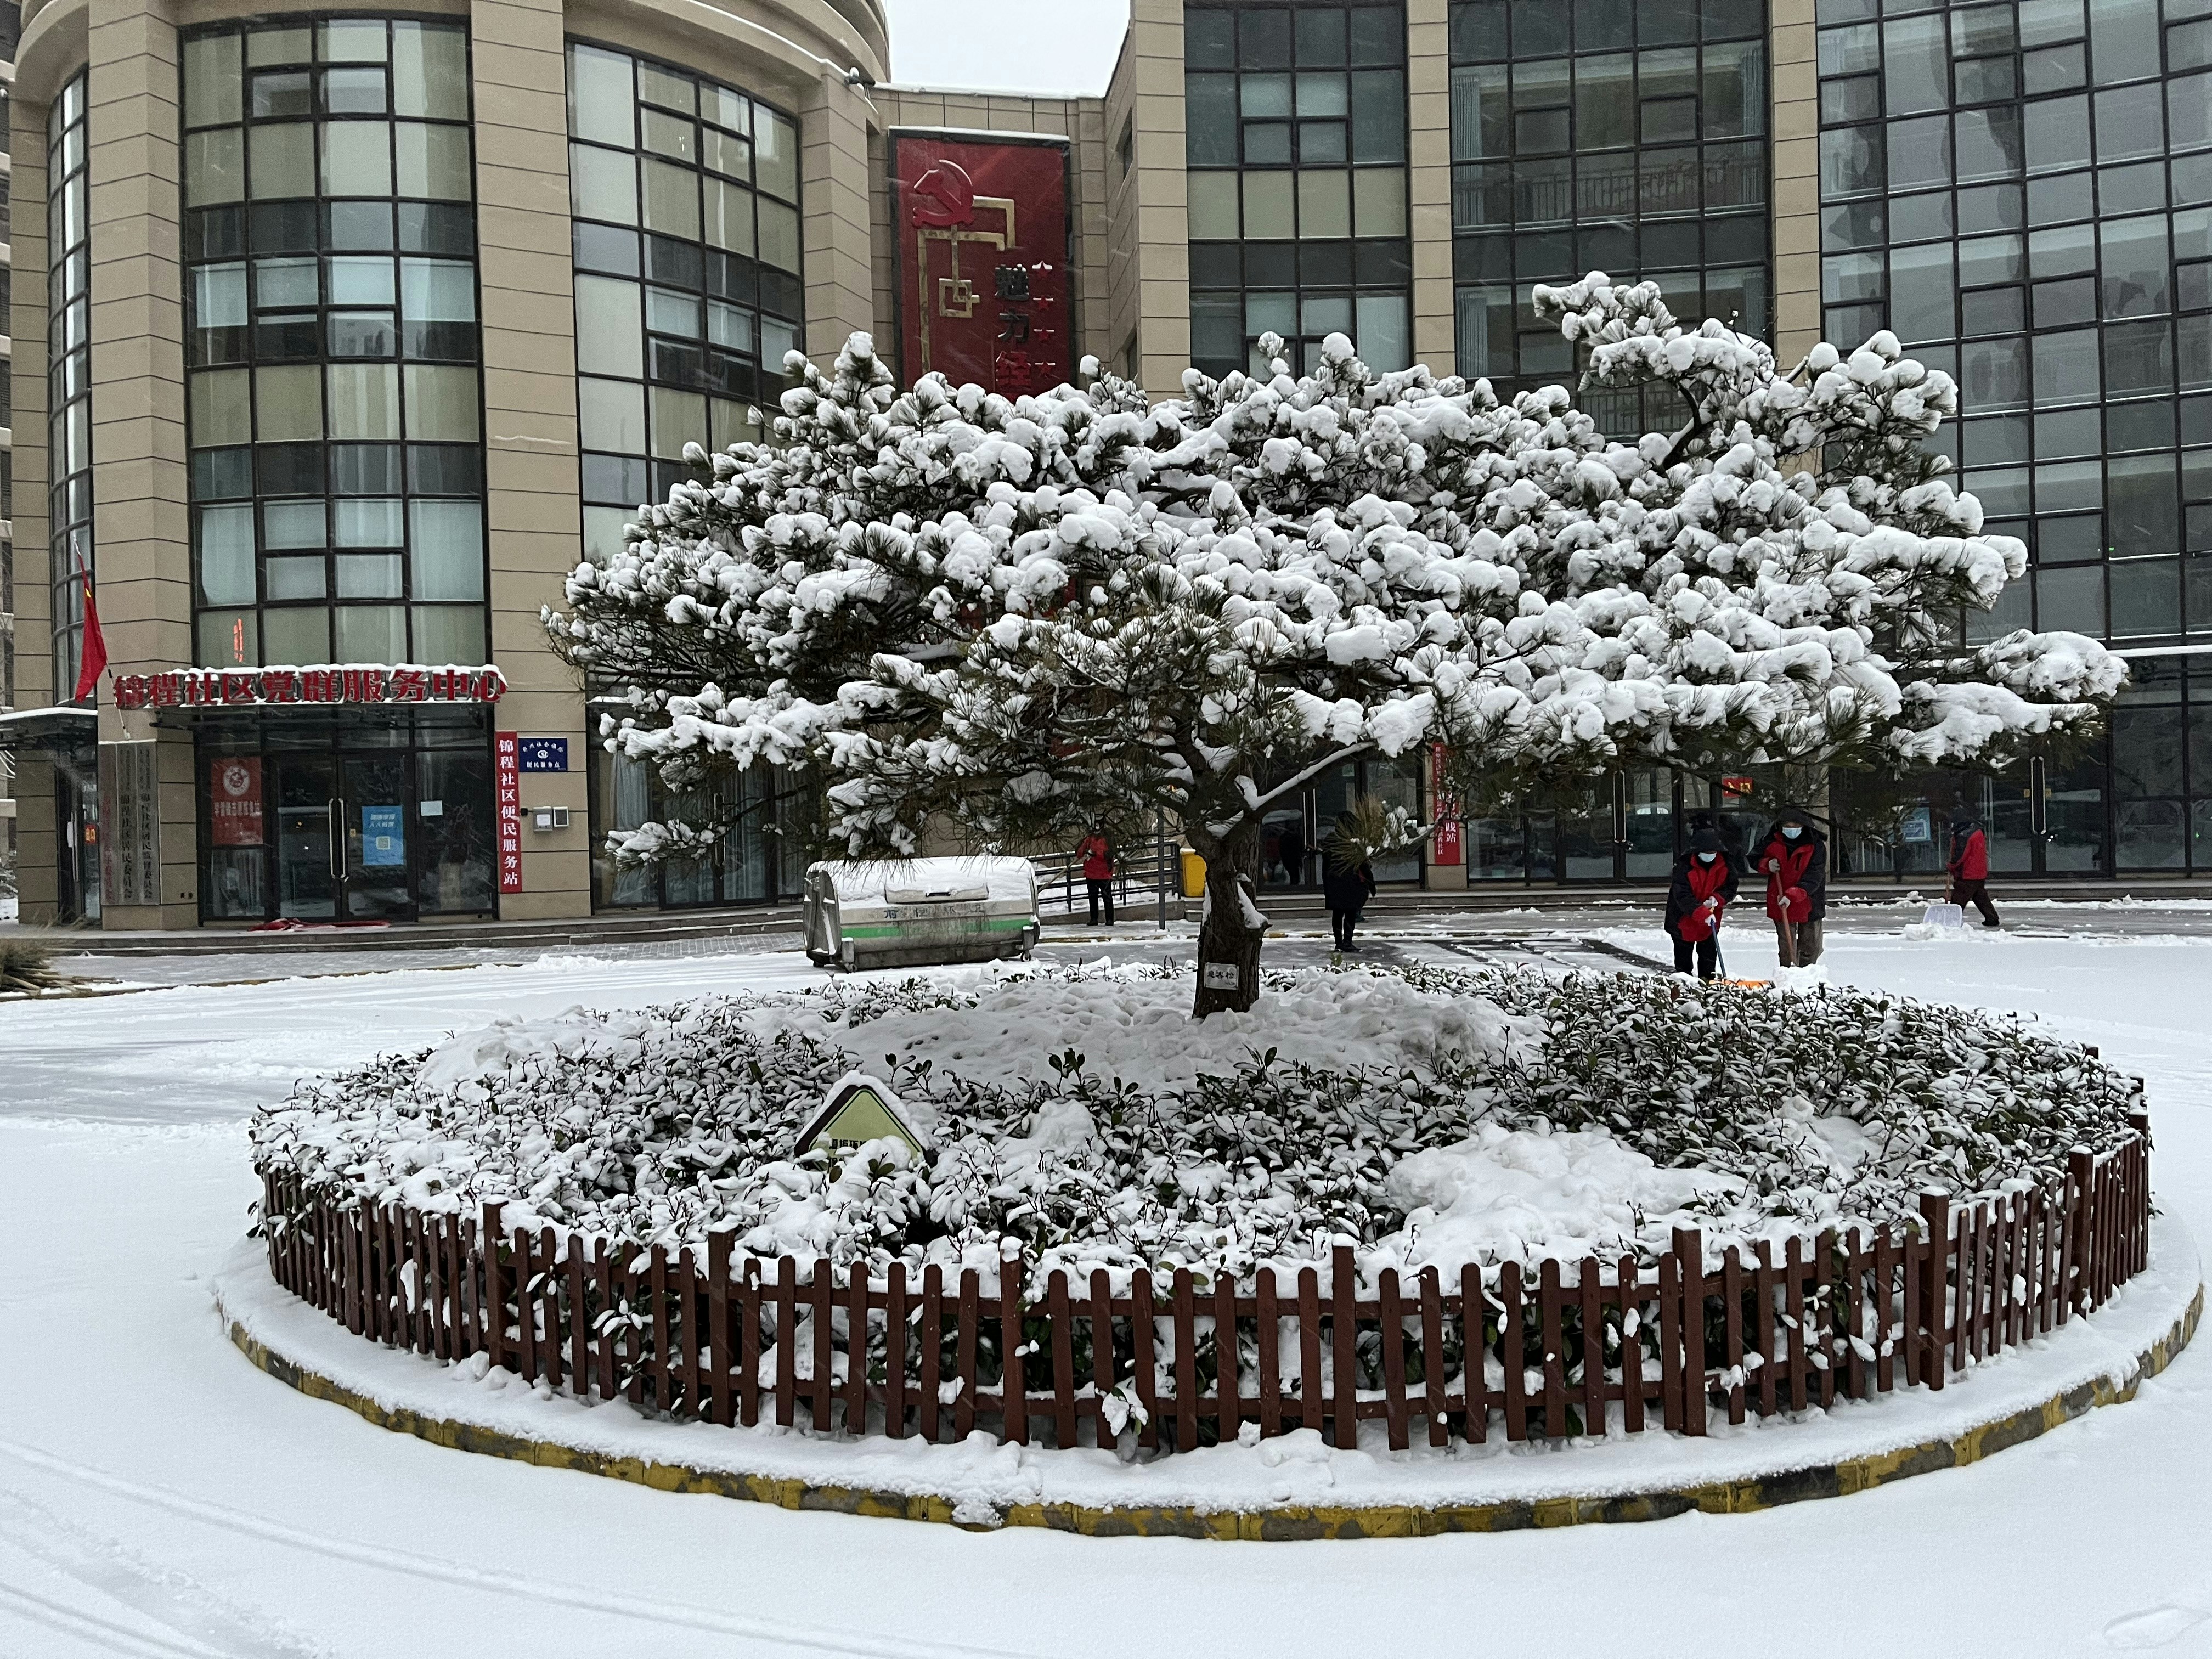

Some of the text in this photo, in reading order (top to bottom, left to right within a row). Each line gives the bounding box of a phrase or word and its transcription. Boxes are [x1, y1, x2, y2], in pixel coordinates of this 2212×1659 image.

[114, 669, 507, 709] 锦程社区党群服务中心
[499, 740, 518, 885] 锦程社区便民服务站
